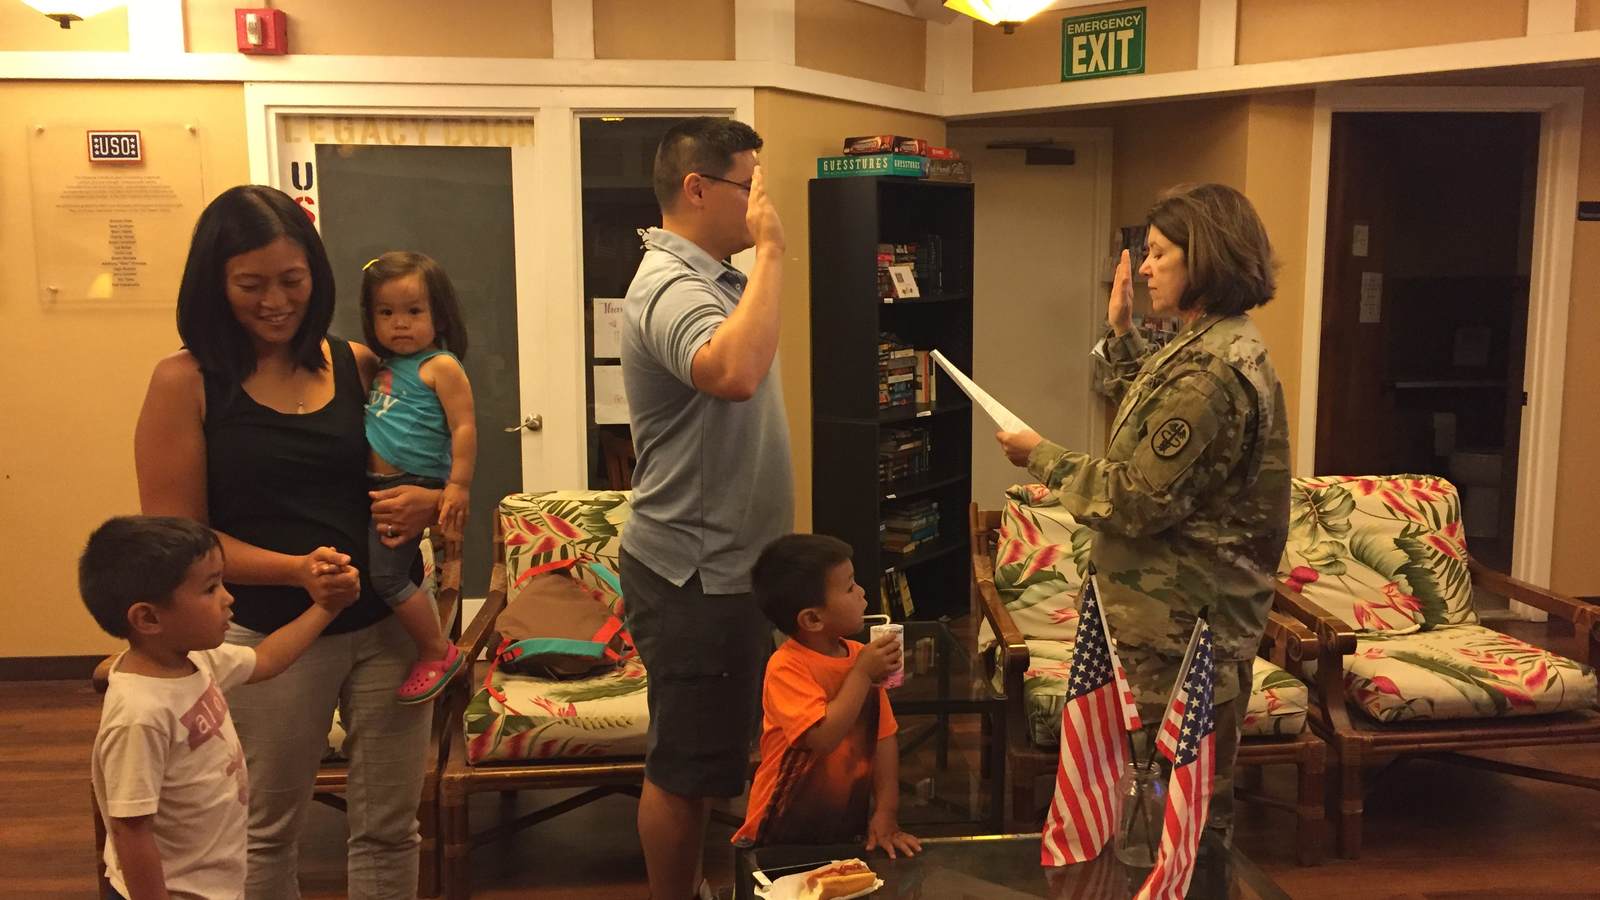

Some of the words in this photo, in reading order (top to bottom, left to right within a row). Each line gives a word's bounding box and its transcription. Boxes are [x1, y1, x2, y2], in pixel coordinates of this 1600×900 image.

[1067, 15, 1141, 34] EMERGENCY
[1072, 29, 1134, 74] EXIT
[281, 115, 430, 144] LEGACY
[99, 136, 131, 155] USO
[823, 157, 888, 172] GUESSTURES
